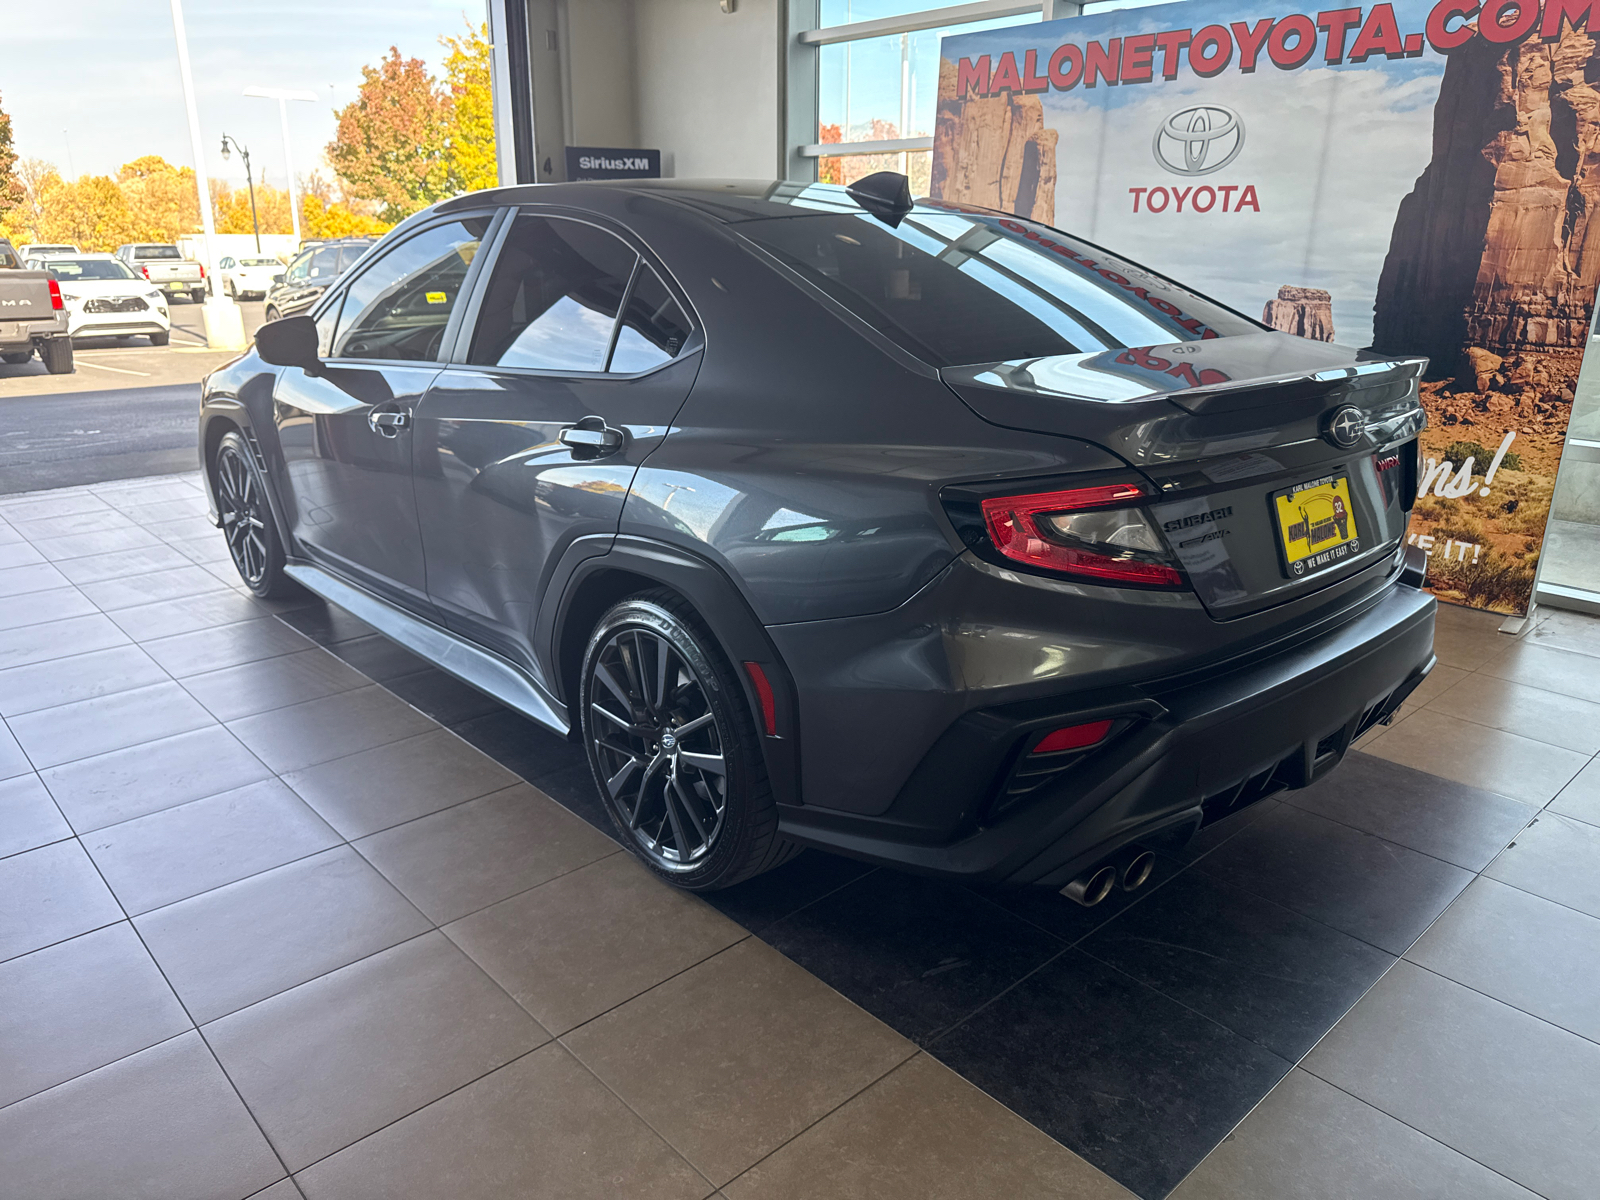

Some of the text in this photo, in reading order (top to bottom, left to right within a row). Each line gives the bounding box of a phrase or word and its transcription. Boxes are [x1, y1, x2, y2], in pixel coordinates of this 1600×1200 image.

[957, 0, 1600, 99] MALONETOYOTA.COM
[543, 156, 553, 176] 4
[579, 157, 650, 170] SiriusXM
[1128, 184, 1261, 213] TOYOTA
[1376, 455, 1400, 472] WRX
[1292, 476, 1333, 493] KARL MALONE TOYOTA
[1335, 501, 1343, 513] 32
[1163, 505, 1235, 533] SUBARU
[1288, 521, 1306, 544] KARL
[1310, 521, 1337, 546] MALONE
[1307, 545, 1348, 568] WE MAKE IT EASY
[1443, 539, 1482, 565] IT!
